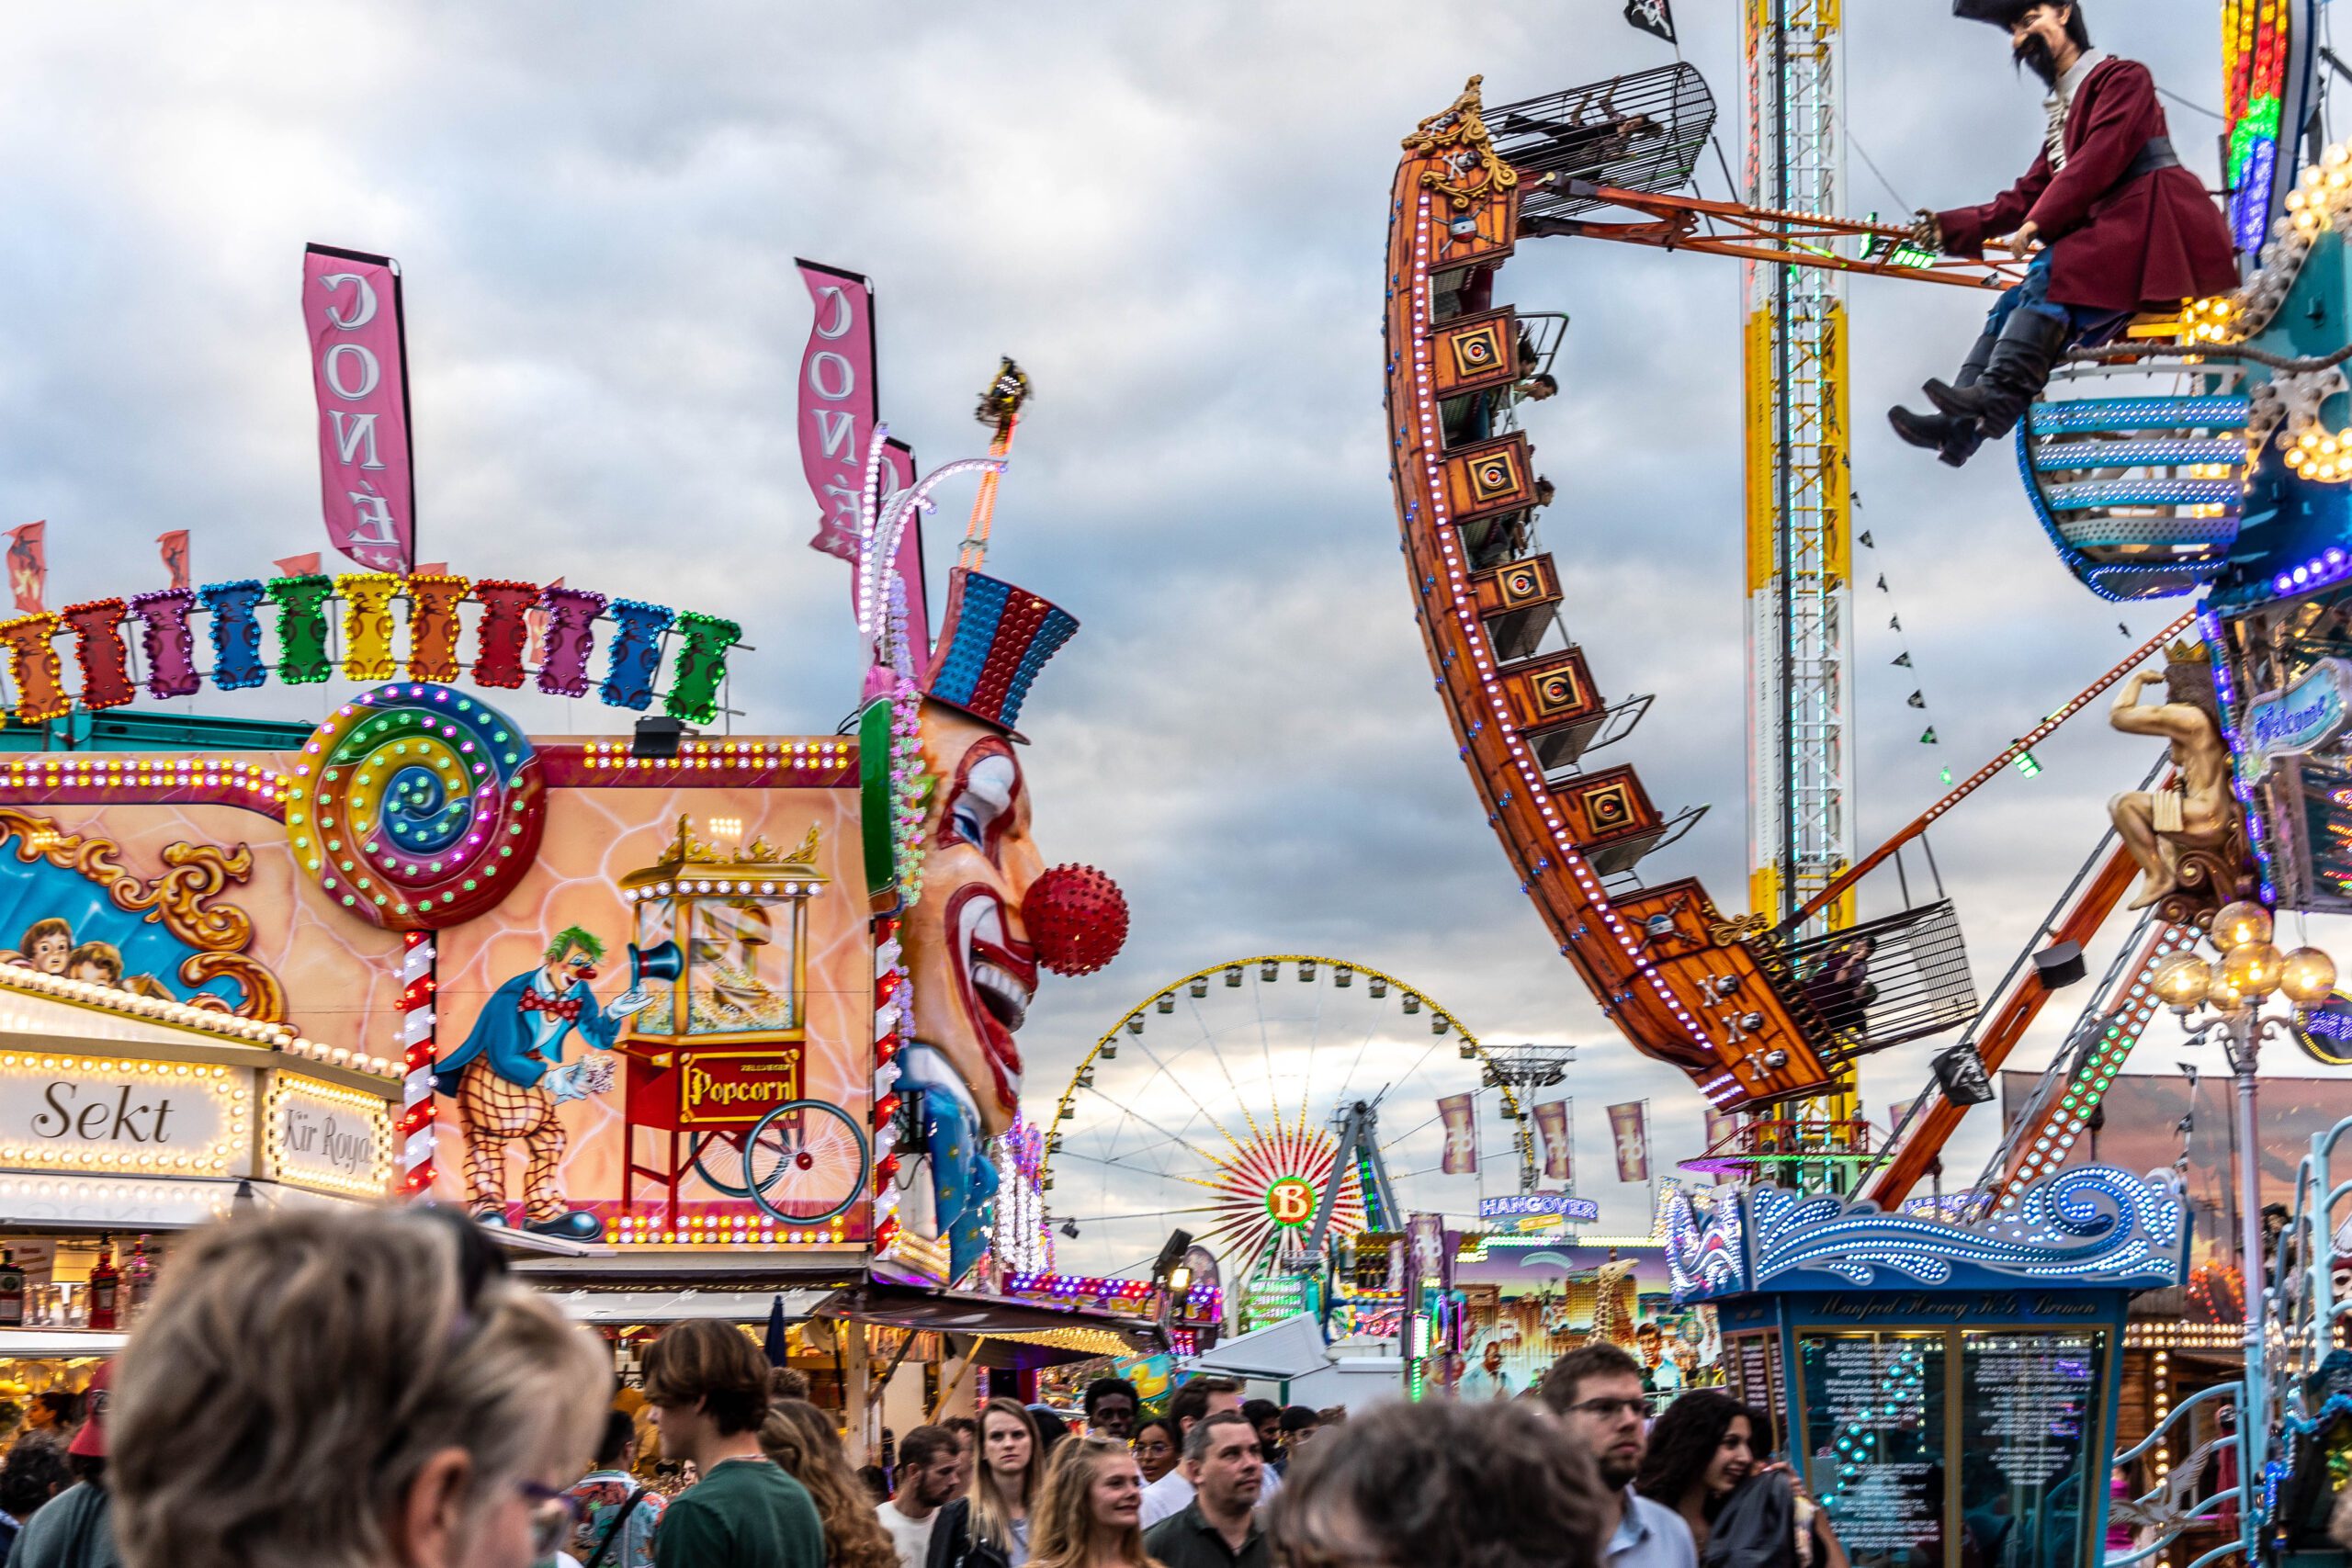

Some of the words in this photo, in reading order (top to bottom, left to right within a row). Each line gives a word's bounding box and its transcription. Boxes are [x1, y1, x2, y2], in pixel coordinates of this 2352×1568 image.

[689, 1067, 791, 1105] Popcorn
[30, 1081, 175, 1144] Sekt
[279, 1108, 318, 1152] Kir
[1272, 1185, 1307, 1218] B
[1480, 1195, 1598, 1219] HANGOVER
